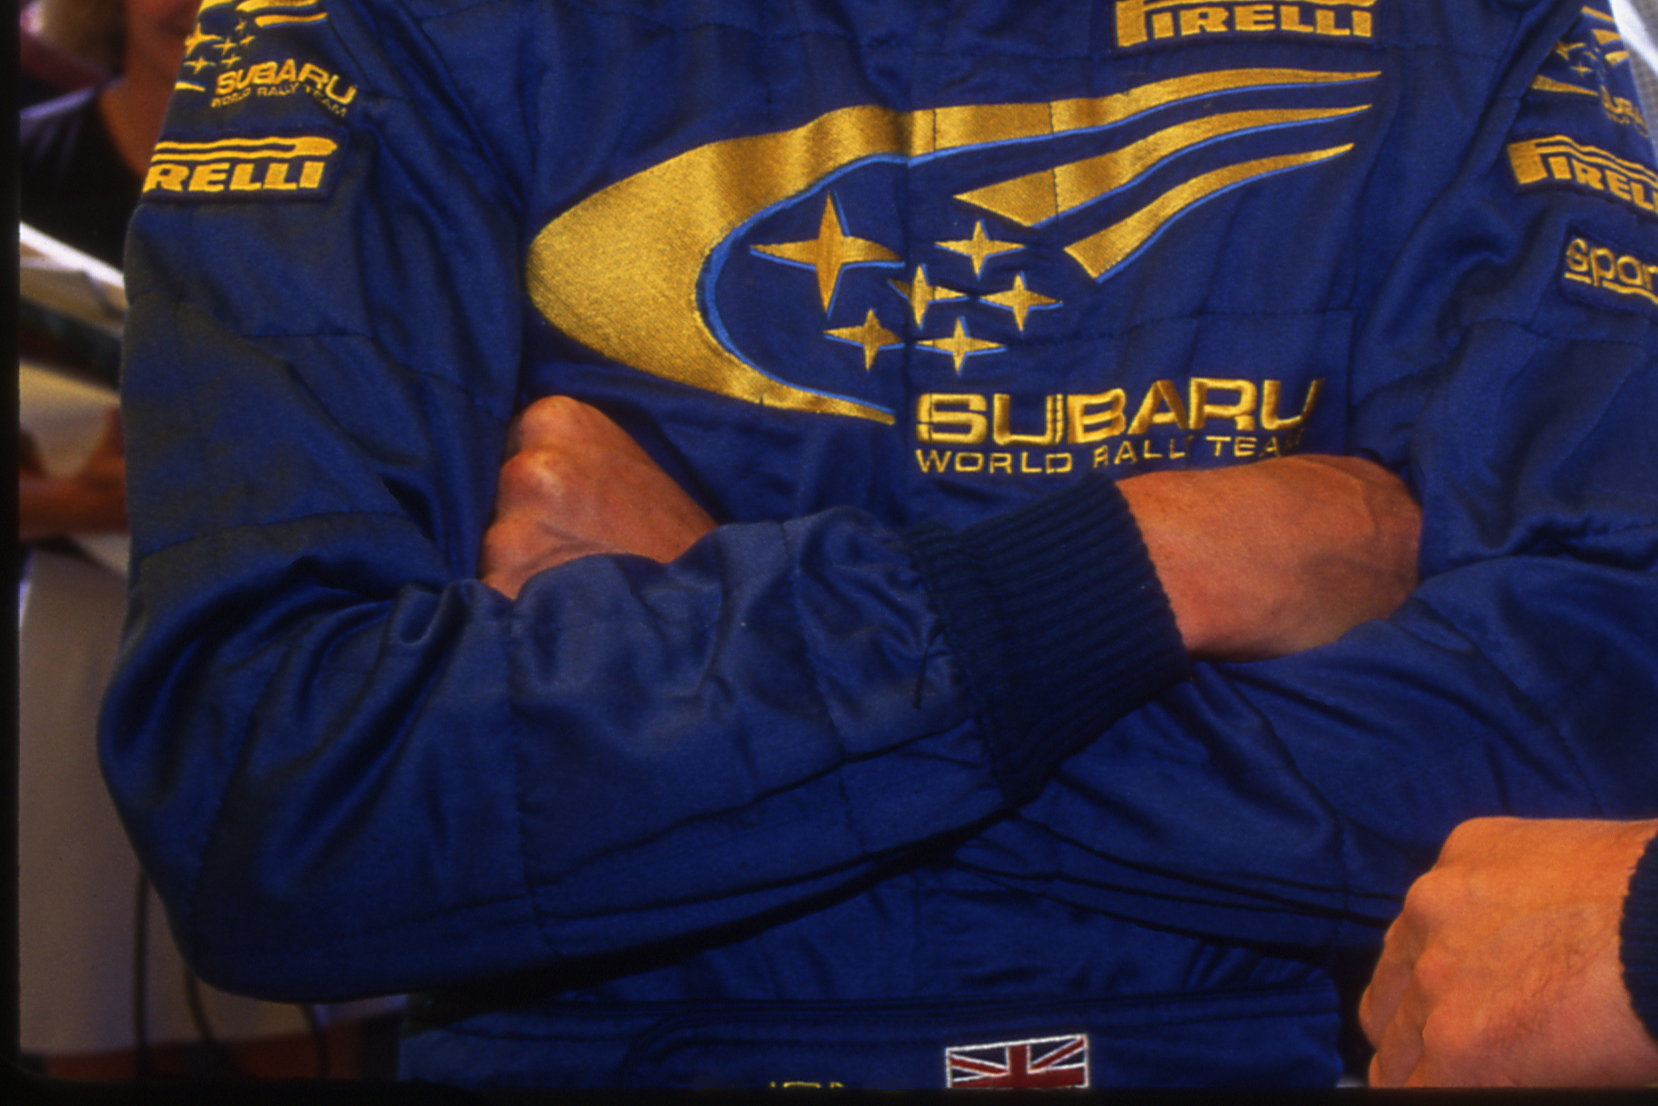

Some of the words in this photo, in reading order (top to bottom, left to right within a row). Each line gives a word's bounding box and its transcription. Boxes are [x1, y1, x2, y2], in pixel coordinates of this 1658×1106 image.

[210, 87, 252, 108] WORLD
[256, 81, 300, 98] RALLY
[303, 83, 348, 118] TEAM
[215, 58, 358, 105] SUBARU
[142, 137, 338, 193] RELLI
[916, 377, 1327, 447] SUBARU
[915, 449, 1073, 475] WORLD
